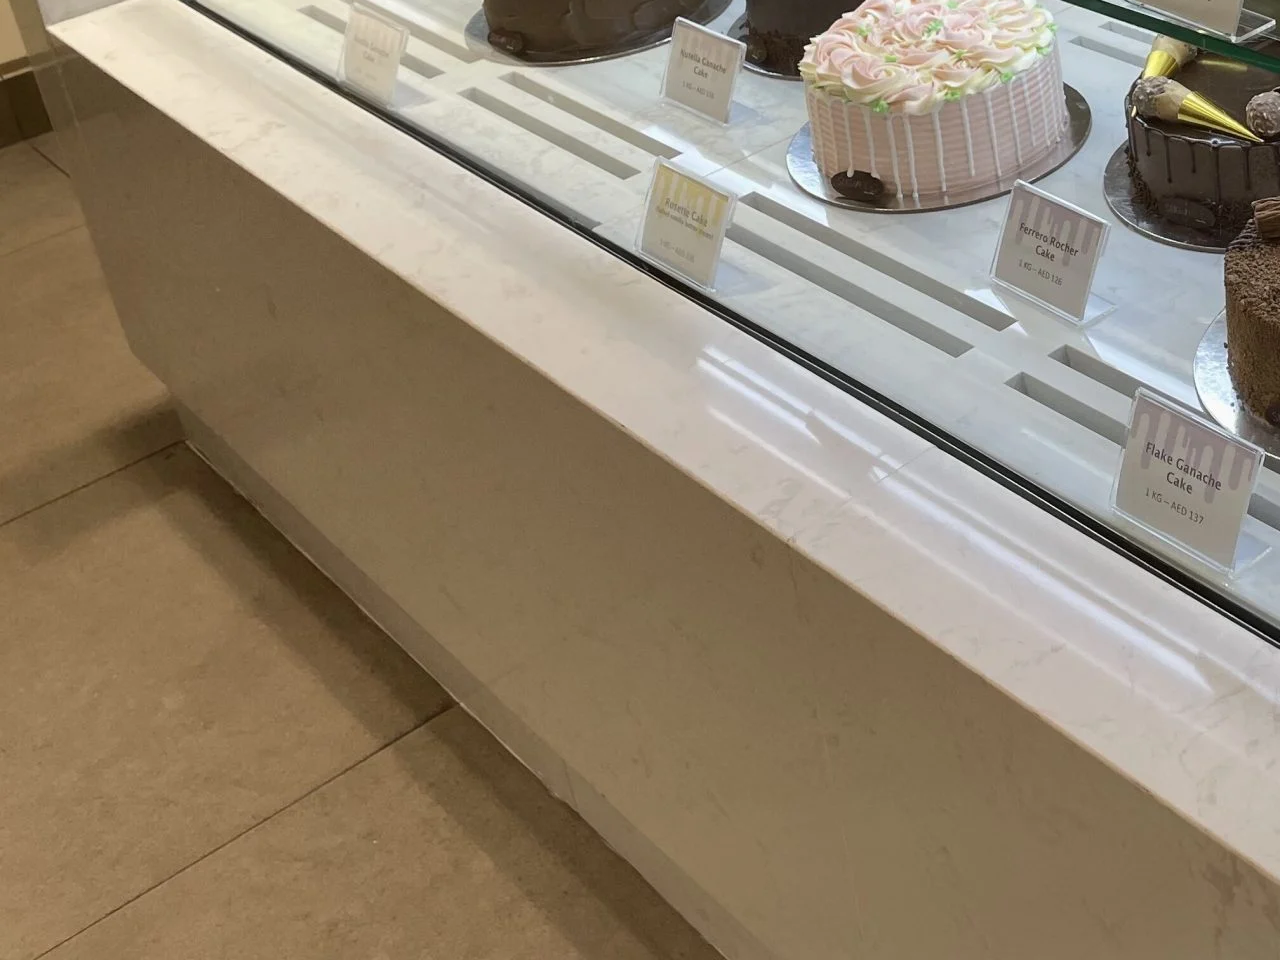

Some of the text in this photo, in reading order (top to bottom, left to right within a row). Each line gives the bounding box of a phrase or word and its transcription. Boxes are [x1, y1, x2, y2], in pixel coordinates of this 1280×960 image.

[694, 66, 708, 78] Cake
[1020, 222, 1079, 257] Ferrero Rocher
[1035, 245, 1055, 261] Cake
[1038, 268, 1050, 280] AED
[1146, 441, 1222, 491] Flake Ganache
[1166, 472, 1193, 494] Cake
[1151, 490, 1162, 503] KG
[1170, 501, 1187, 516] AED
[1189, 511, 1204, 525] 137
